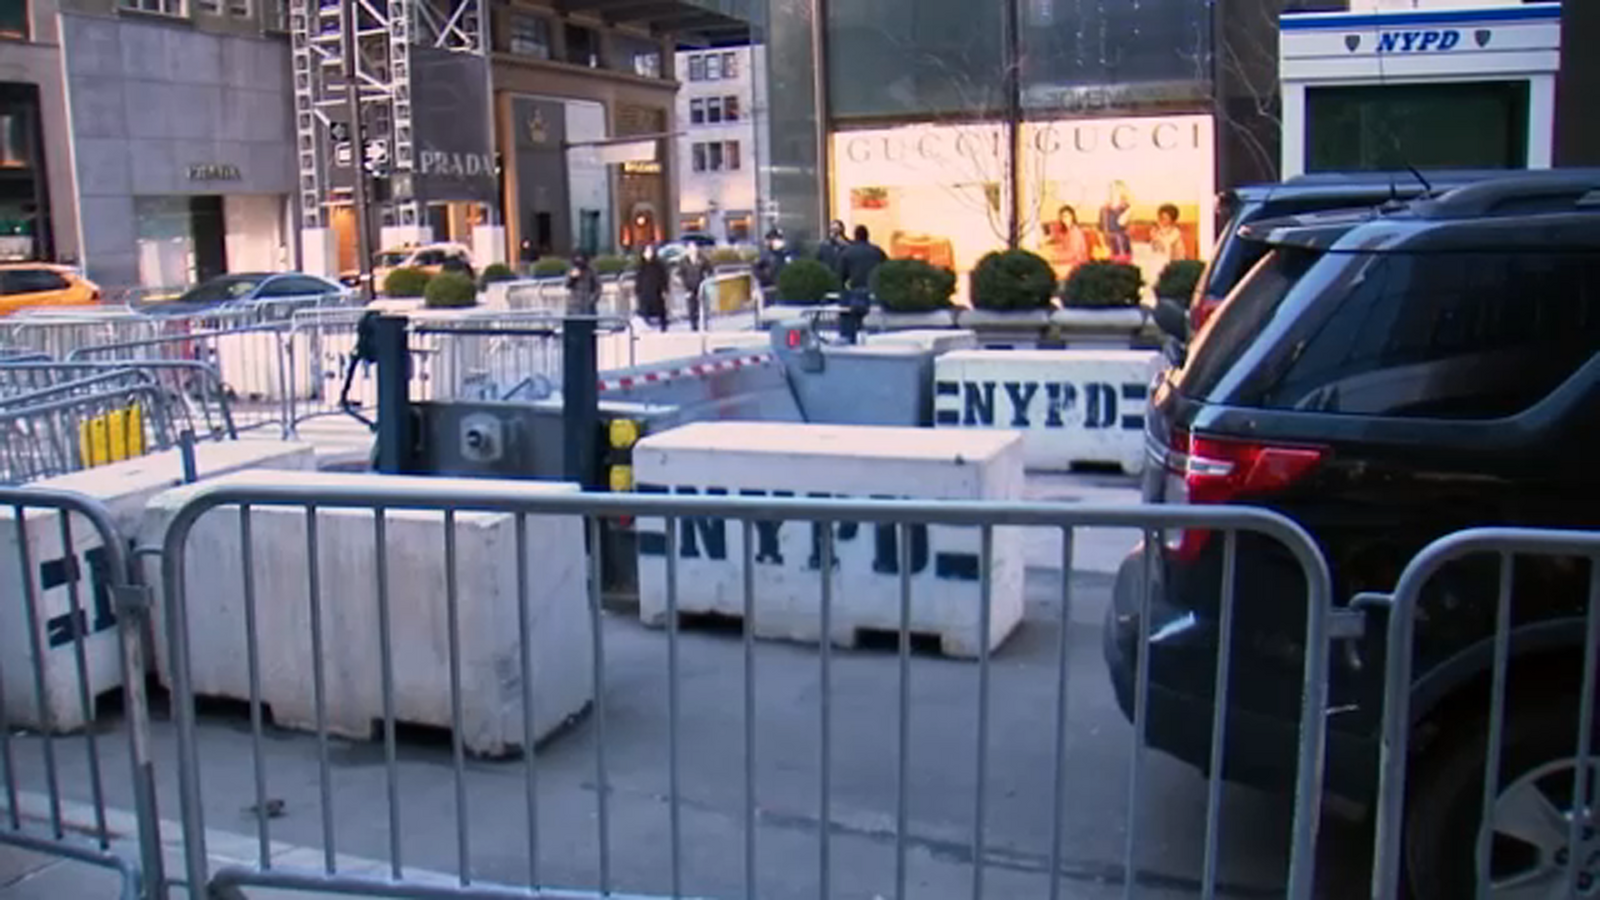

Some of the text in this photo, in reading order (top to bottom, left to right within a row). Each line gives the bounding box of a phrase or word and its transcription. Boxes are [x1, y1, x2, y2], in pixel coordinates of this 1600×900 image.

[1376, 30, 1461, 52] NYPD
[845, 130, 999, 164] GUCCI
[1034, 122, 1200, 154] GUCCI
[962, 380, 1117, 429] NYPD
